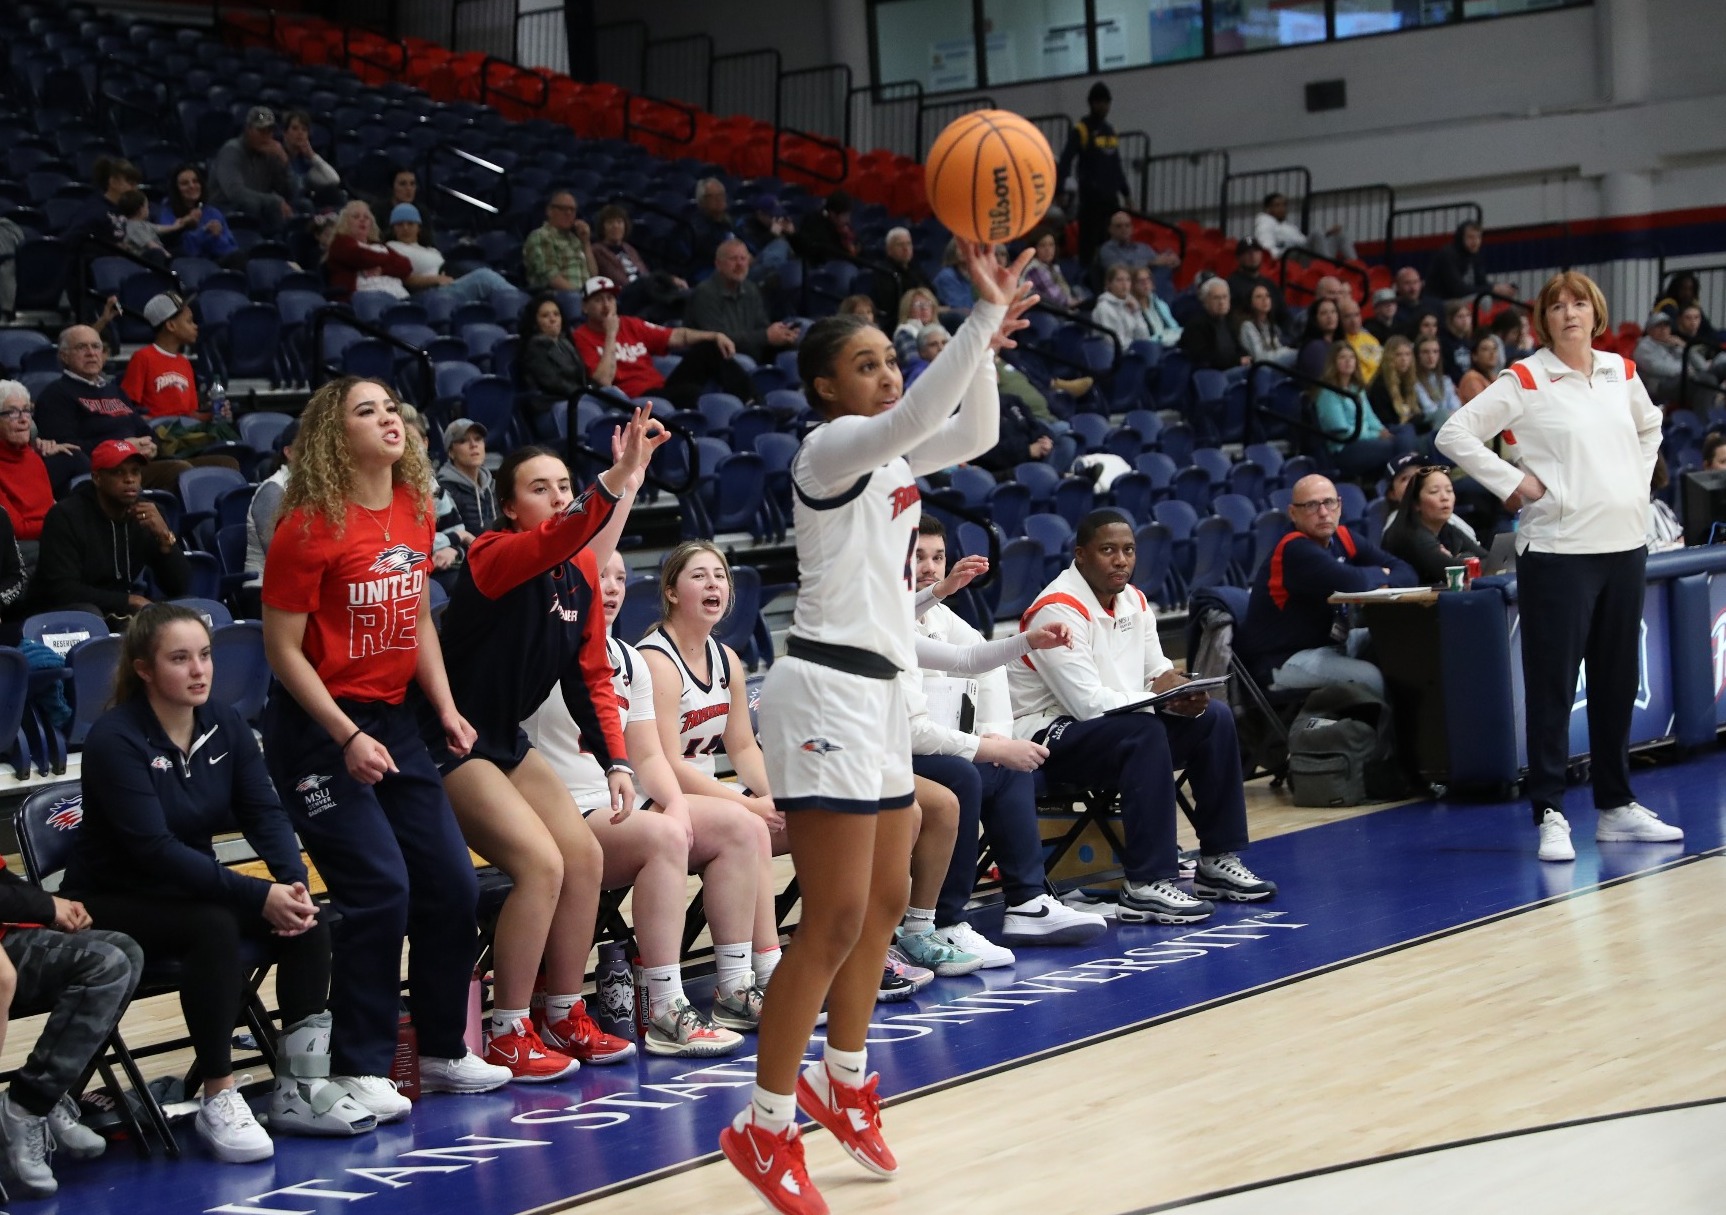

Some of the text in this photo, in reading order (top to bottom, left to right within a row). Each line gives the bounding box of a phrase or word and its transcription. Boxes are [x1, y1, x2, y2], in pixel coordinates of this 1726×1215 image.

[988, 166, 1010, 240] Wilson
[348, 569, 423, 605] UNITED
[305, 788, 330, 804] MSU
[308, 797, 331, 811] DENVER
[809, 918, 1308, 1043] UNIVERSITY
[641, 985, 649, 1025] BODYARMO
